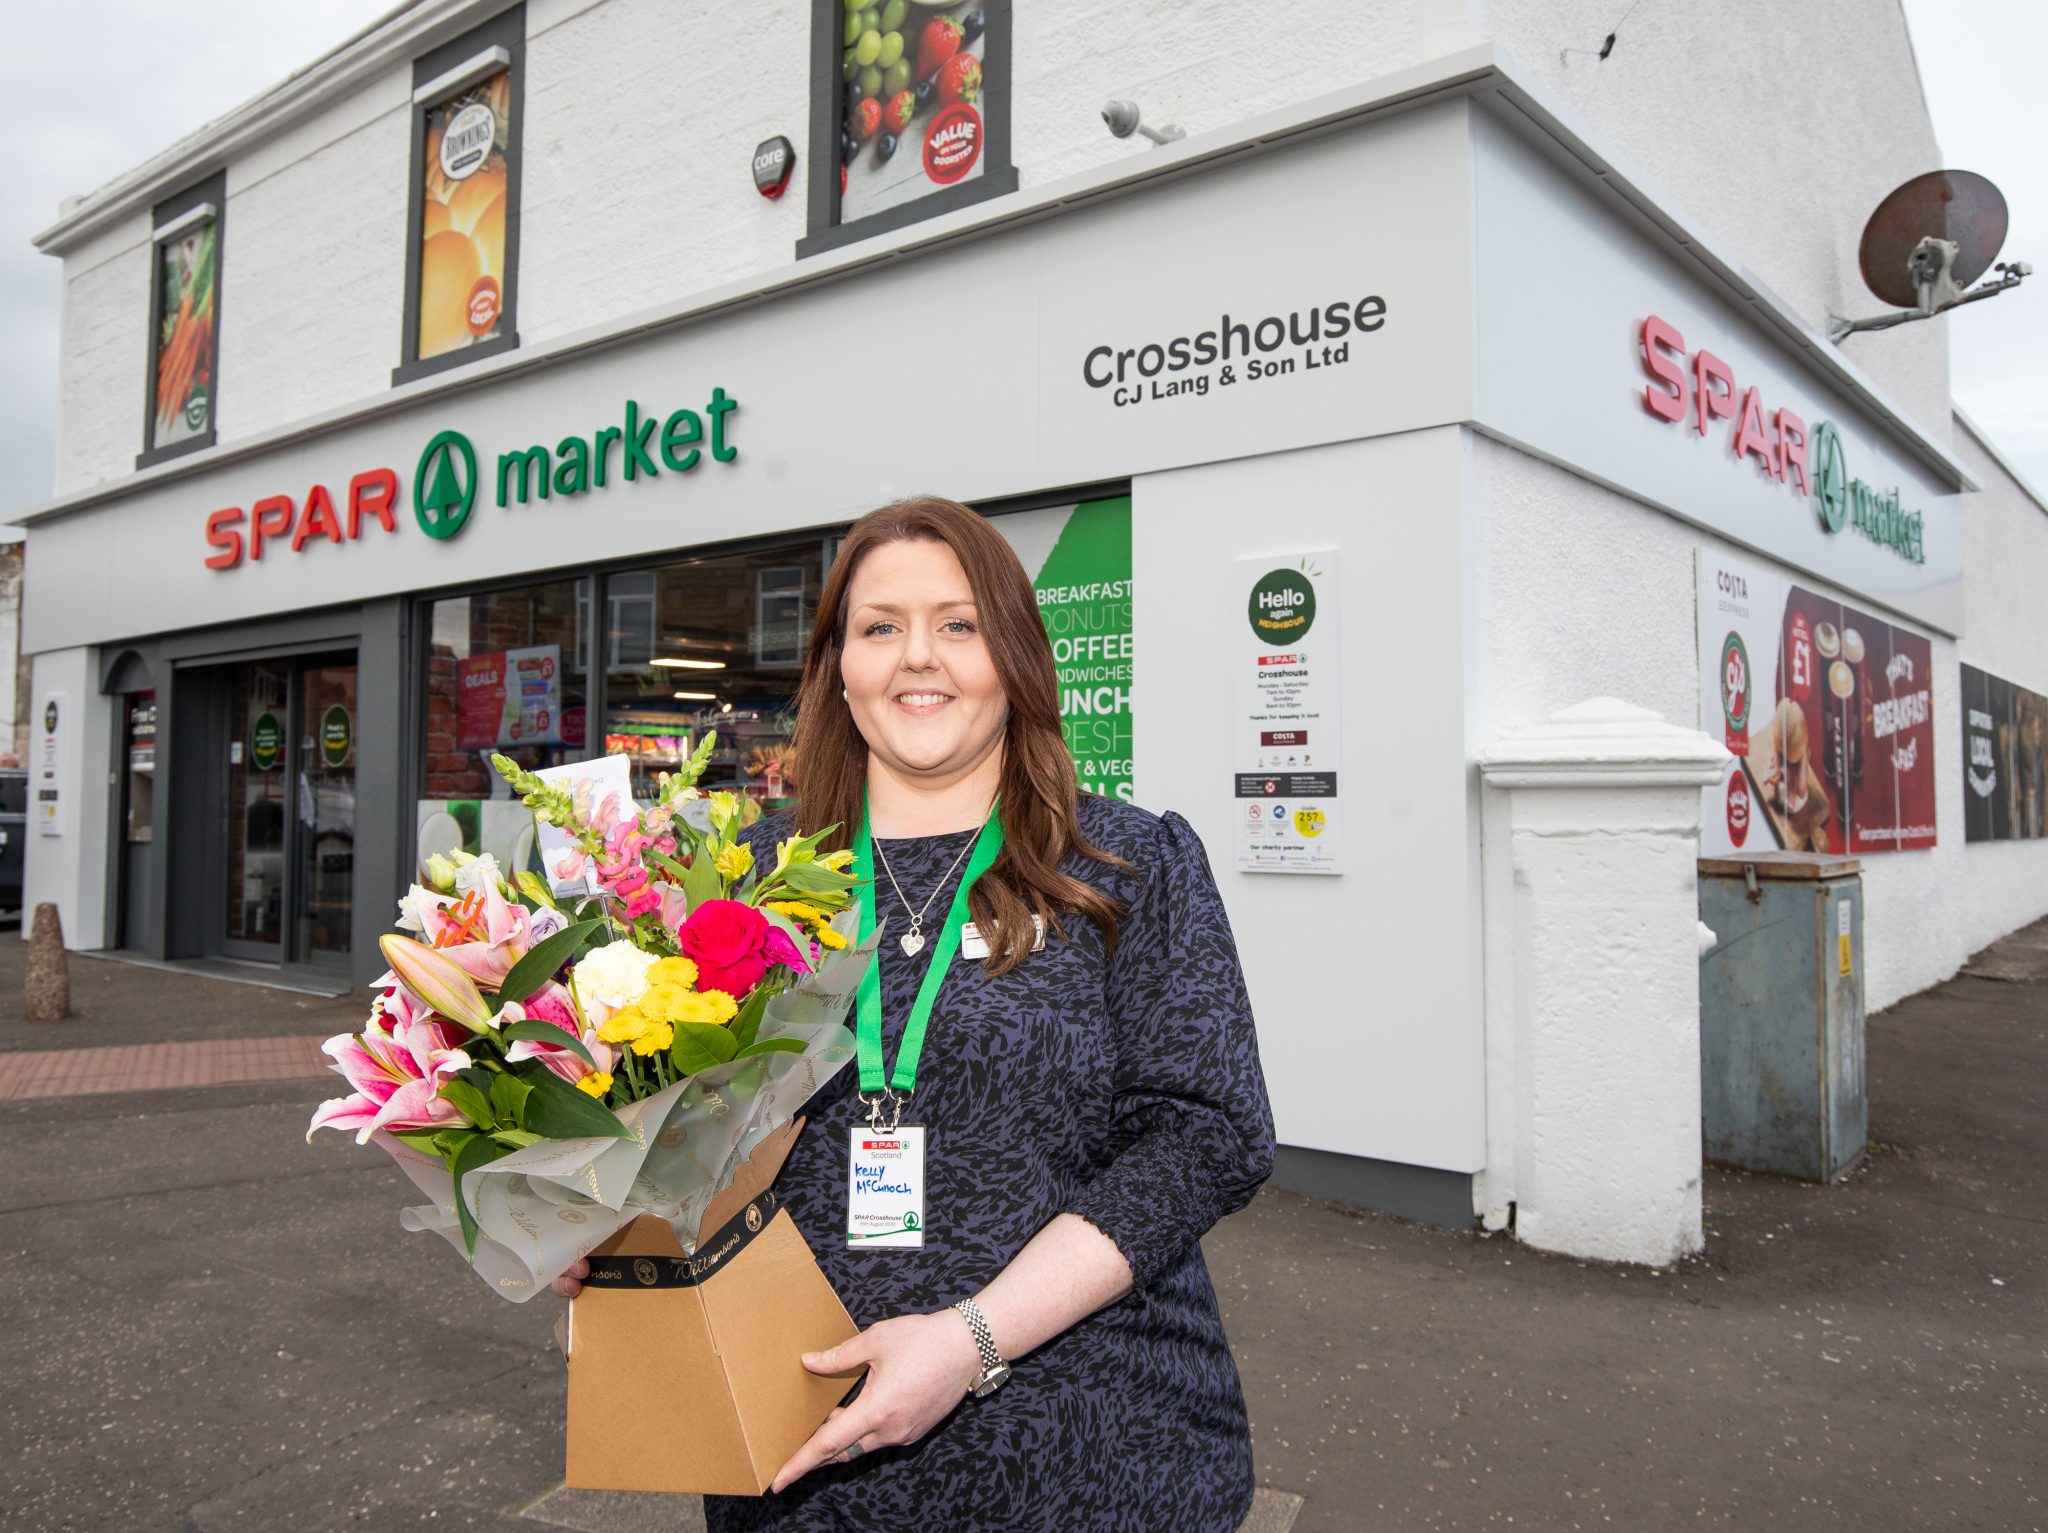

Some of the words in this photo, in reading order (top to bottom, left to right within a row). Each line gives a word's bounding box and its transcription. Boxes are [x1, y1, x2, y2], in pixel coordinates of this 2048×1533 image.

[929, 121, 976, 149] VALUE
[754, 149, 784, 170] core
[934, 145, 973, 165] DOORSTEP
[1083, 295, 1387, 388] Crosshouse
[1113, 384, 1143, 407] CJ
[1151, 374, 1210, 400] Lang
[1219, 365, 1237, 386] &
[1246, 357, 1295, 381] Son
[1306, 341, 1350, 370] Ltd
[1641, 314, 1809, 497] SPAR
[1851, 477, 1926, 565] market
[205, 467, 399, 570] SPAR
[496, 387, 739, 508] market
[1036, 580, 1132, 605] BREAKFAST
[1717, 569, 1749, 599] COSTA
[1258, 588, 1305, 609] Hello
[1270, 608, 1294, 620] again
[1051, 633, 1132, 663] OFFEE
[1266, 655, 1297, 665] SPAR
[465, 671, 498, 688] DEALS
[1056, 665, 1133, 684] NDWICHES
[1258, 669, 1308, 679] Crosshouse
[1059, 686, 1133, 717] UNCH
[1873, 690, 1928, 738] BREAKFAST
[1061, 720, 1133, 754] ESH
[1273, 733, 1295, 741] COSTA
[1099, 759, 1133, 777] VEG
[871, 1141, 900, 1150] SPAR
[871, 1151, 902, 1159] Scotland
[590, 1269, 622, 1280] nson's
